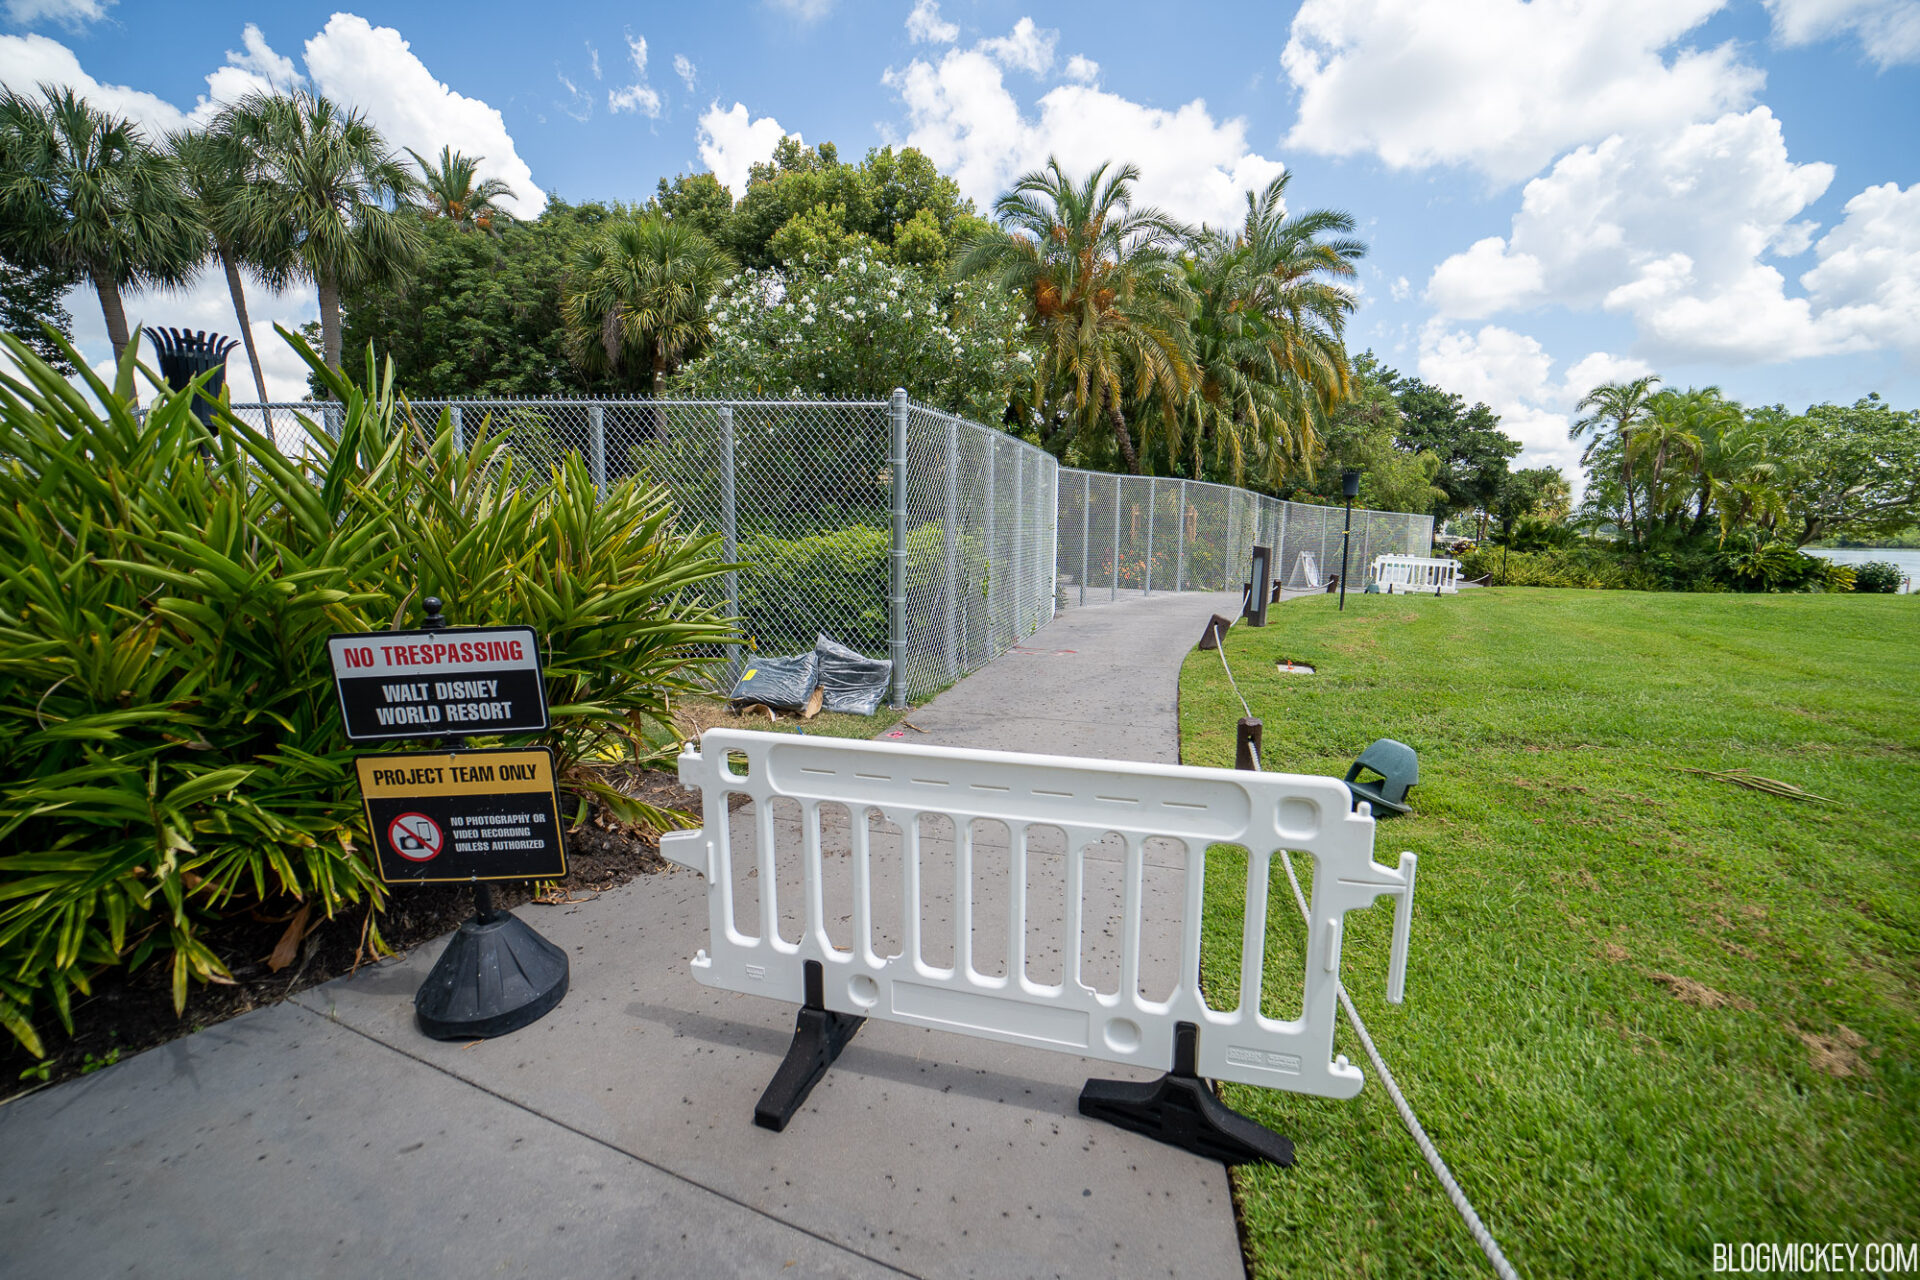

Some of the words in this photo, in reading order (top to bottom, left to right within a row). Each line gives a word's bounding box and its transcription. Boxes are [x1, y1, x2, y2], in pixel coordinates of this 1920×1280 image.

[344, 647, 375, 668] NO
[381, 640, 523, 666] TRESPASSING
[382, 683, 428, 703] WALT
[435, 680, 498, 700] DISNEY
[376, 705, 440, 725] WORLD
[446, 701, 512, 722] RESORT
[373, 768, 445, 785] PROJECT
[449, 766, 495, 782] TEAM
[499, 764, 537, 781] ONLY
[450, 817, 464, 827] NO
[466, 814, 530, 826] PHOTOGRAPHY
[533, 813, 546, 823] OR
[453, 829, 479, 839] VIDEO
[481, 827, 531, 838] RECORDING
[455, 842, 490, 852] UNLESS
[492, 840, 545, 851] AUTHORIZED
